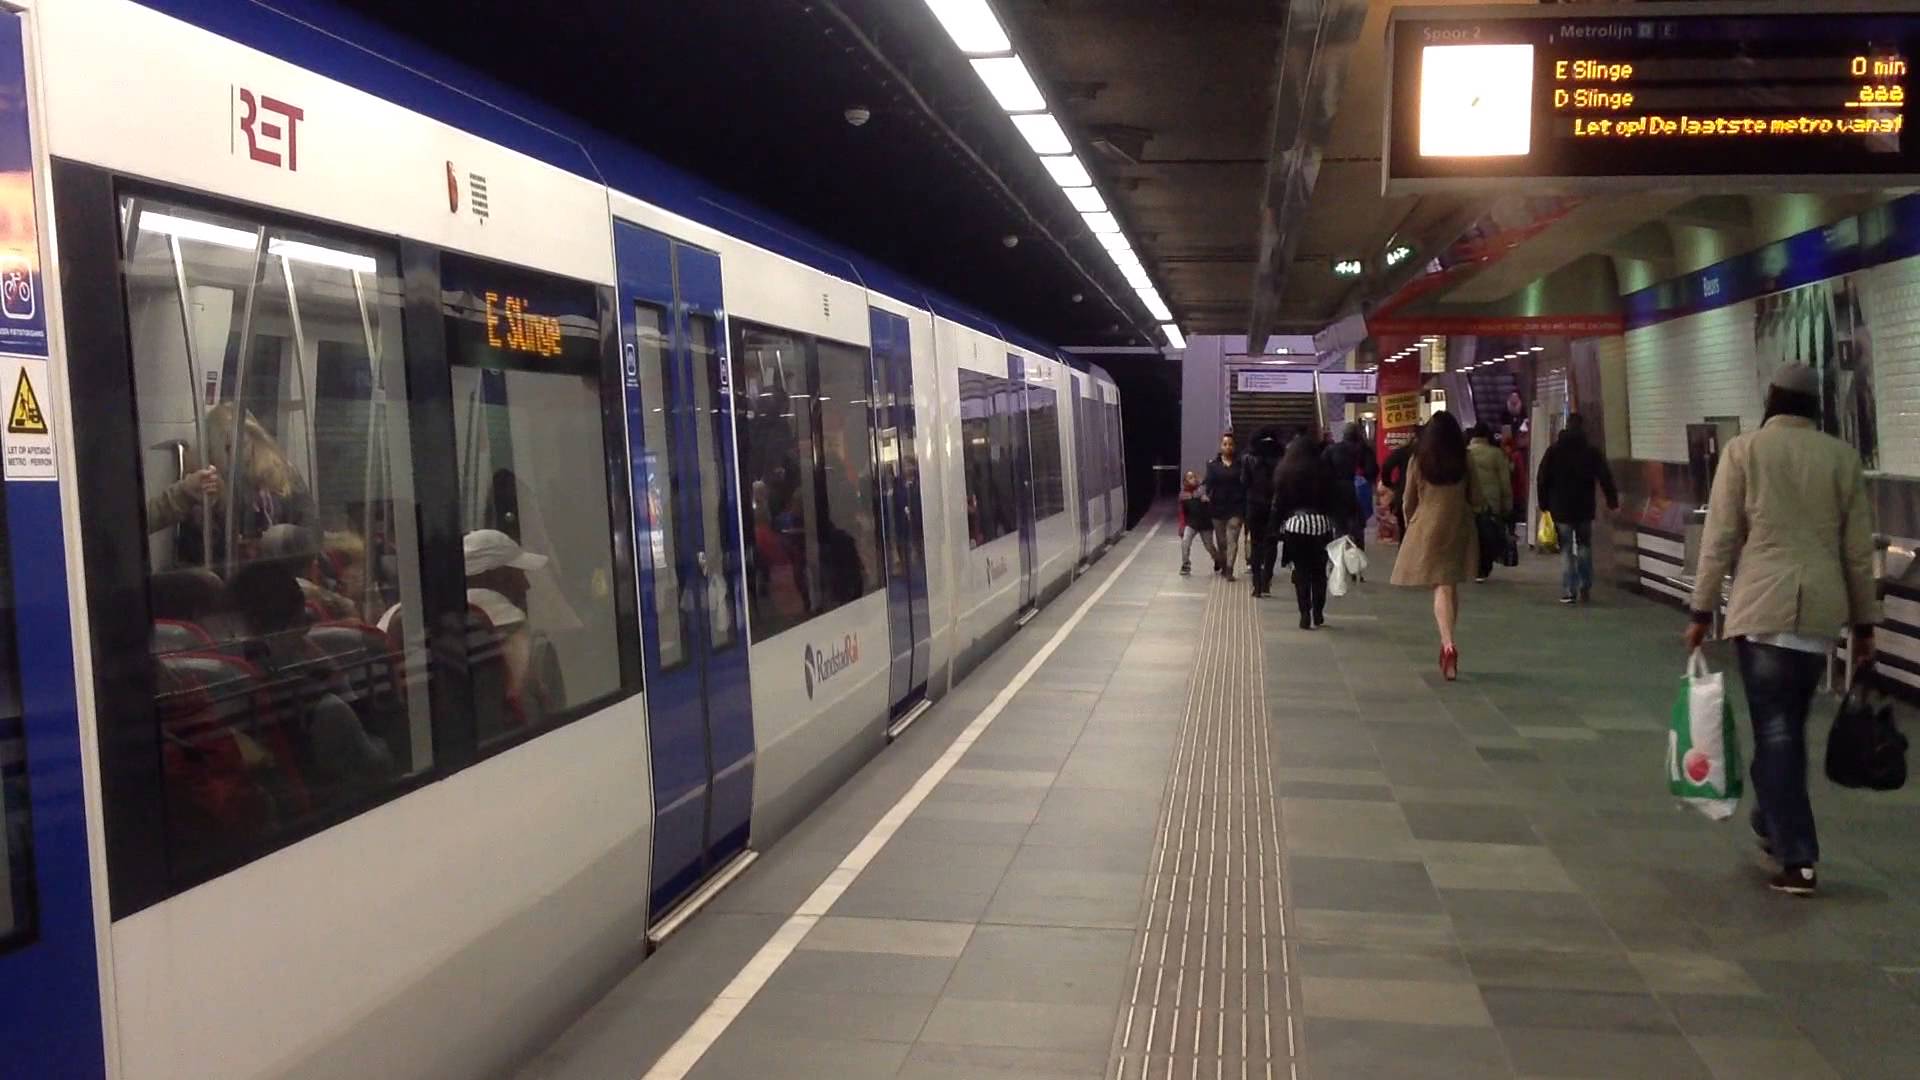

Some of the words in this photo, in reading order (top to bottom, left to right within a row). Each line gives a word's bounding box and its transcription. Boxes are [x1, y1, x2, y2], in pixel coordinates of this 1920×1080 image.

[1423, 27, 1469, 42] Spoor
[1473, 26, 1482, 39] 2
[1560, 24, 1633, 40] Metrolijn
[1555, 60, 1568, 79] E
[1573, 60, 1633, 82] Slinge
[1874, 56, 1906, 75] min
[1554, 89, 1569, 107] D
[1573, 88, 1634, 109] Slinge
[240, 87, 304, 172] RET
[1575, 118, 1613, 135] Let
[1615, 117, 1647, 137] op!
[1649, 116, 1677, 135] De
[1680, 116, 1767, 135] laatste
[1770, 117, 1833, 134] metro
[1837, 114, 1904, 134] vanaf
[485, 292, 502, 347] E
[505, 296, 563, 357] Slinge
